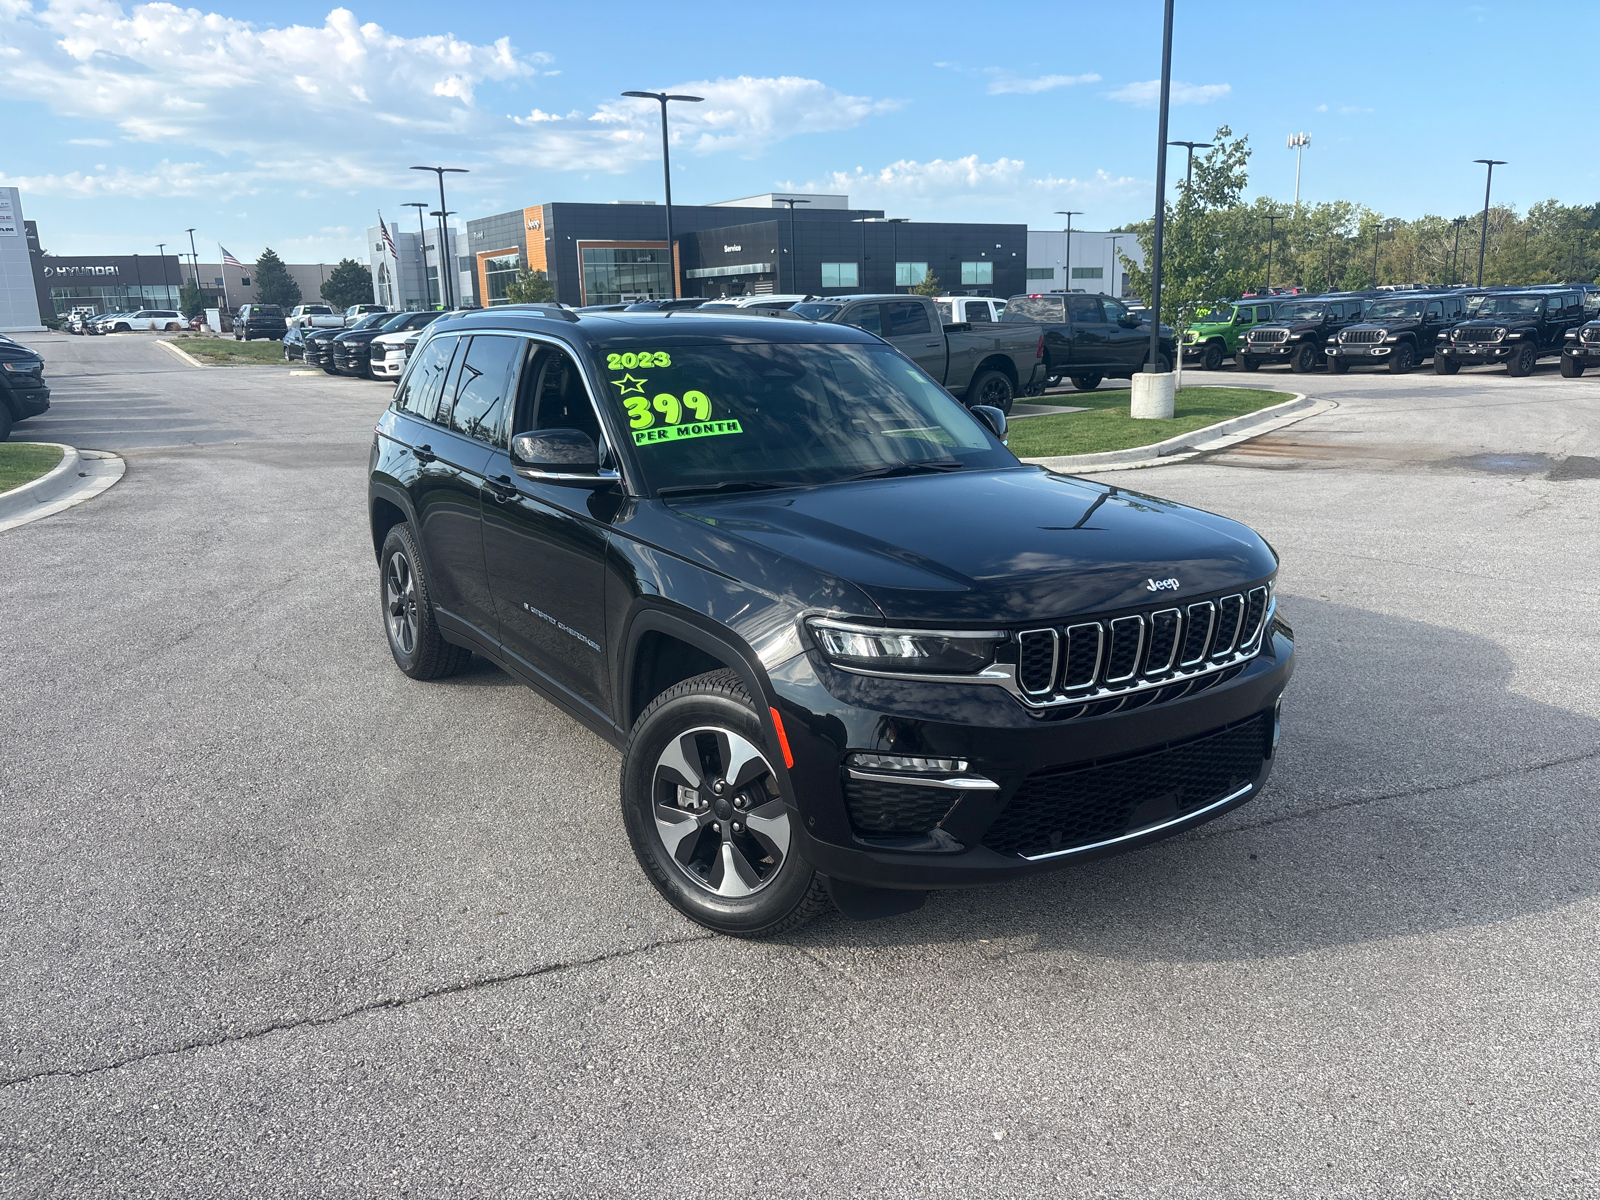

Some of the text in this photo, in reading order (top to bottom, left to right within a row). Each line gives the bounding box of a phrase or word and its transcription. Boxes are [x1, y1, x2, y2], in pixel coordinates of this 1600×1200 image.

[527, 218, 541, 231] Jeep
[723, 243, 742, 253] Service
[56, 265, 120, 277] HYUNDAI
[606, 351, 672, 370] 2023
[622, 390, 713, 430] 399
[635, 421, 739, 444] PER MONTH
[1146, 577, 1180, 592] Jeep
